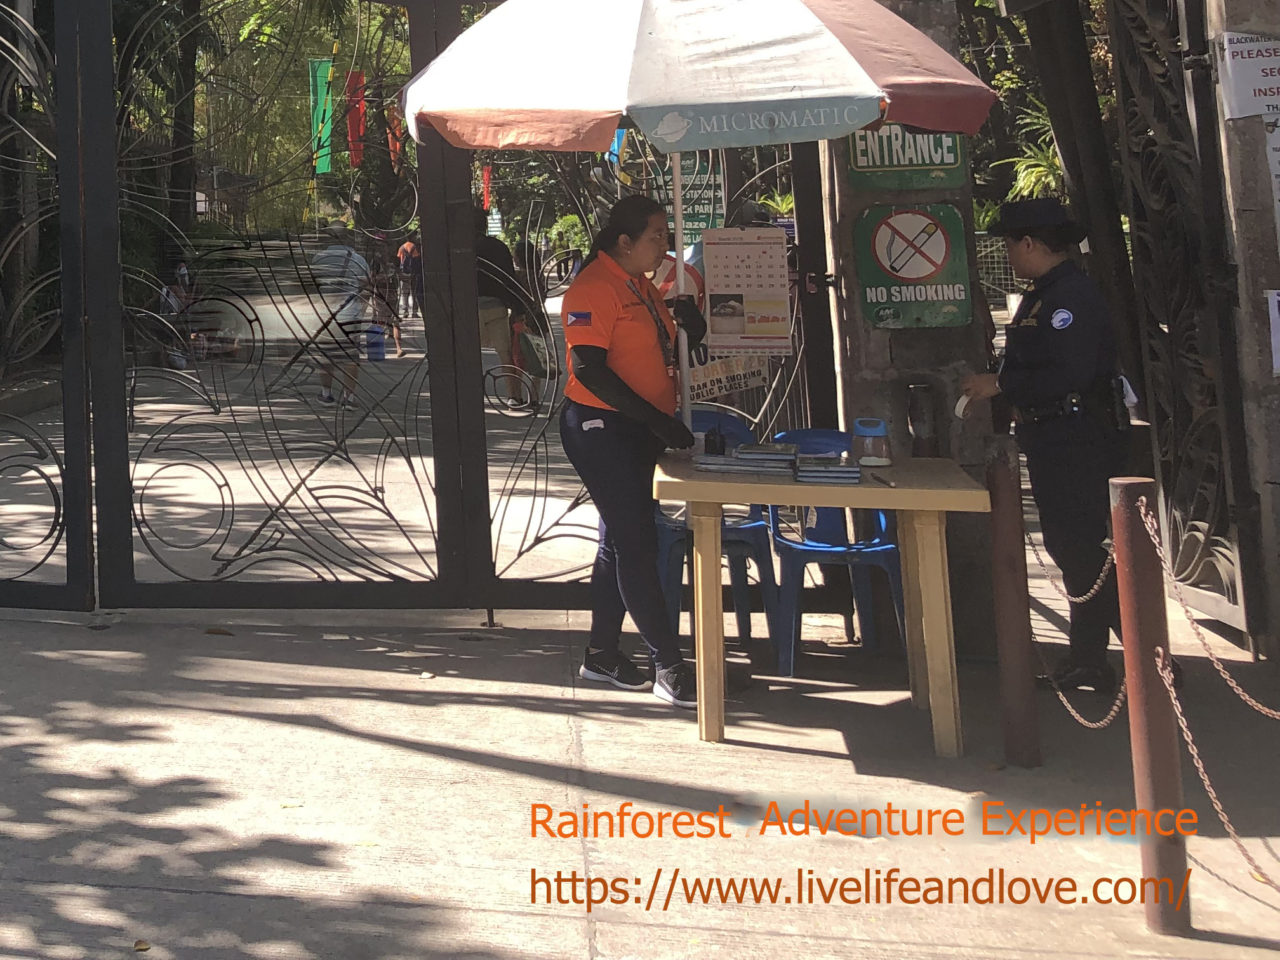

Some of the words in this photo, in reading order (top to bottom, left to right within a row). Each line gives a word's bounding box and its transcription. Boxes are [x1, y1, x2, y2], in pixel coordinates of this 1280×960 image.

[1231, 47, 1280, 60] PLEASE
[1265, 104, 1280, 112] TH
[699, 105, 859, 134] MICROMATIC
[855, 124, 955, 166] ENTRANCE
[666, 204, 693, 214] WER
[866, 287, 887, 303] NO
[890, 284, 966, 302] SMOKING
[689, 382, 707, 393] BAN
[710, 377, 723, 387] ON
[725, 369, 762, 383] SMOKING
[689, 388, 715, 401] UBLIC
[718, 381, 749, 394] PLACES
